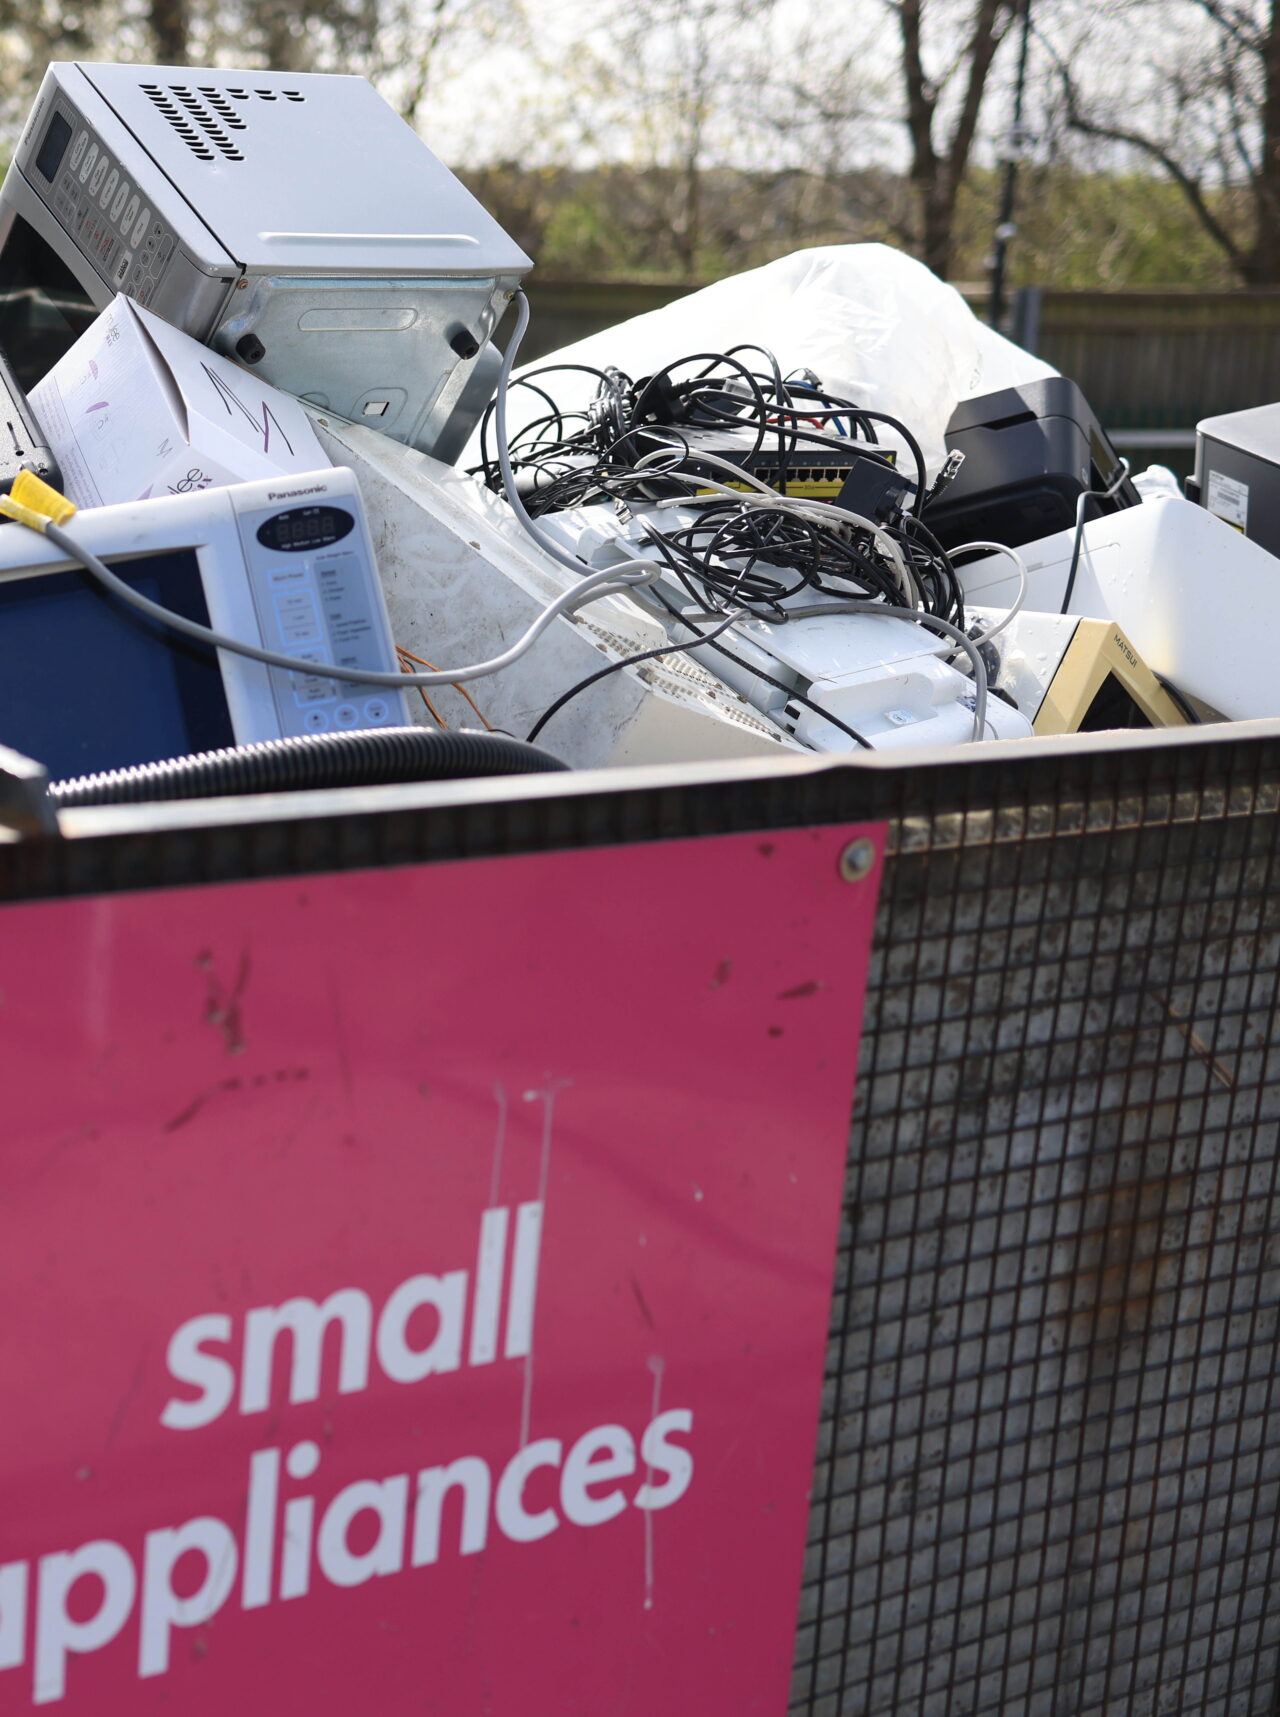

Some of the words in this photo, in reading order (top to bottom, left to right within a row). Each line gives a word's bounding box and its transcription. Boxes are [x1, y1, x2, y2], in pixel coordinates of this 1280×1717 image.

[167, 468, 203, 495] lee
[267, 484, 328, 500] Panasonic
[1114, 634, 1137, 668] MATSUI
[160, 1200, 544, 1430] small
